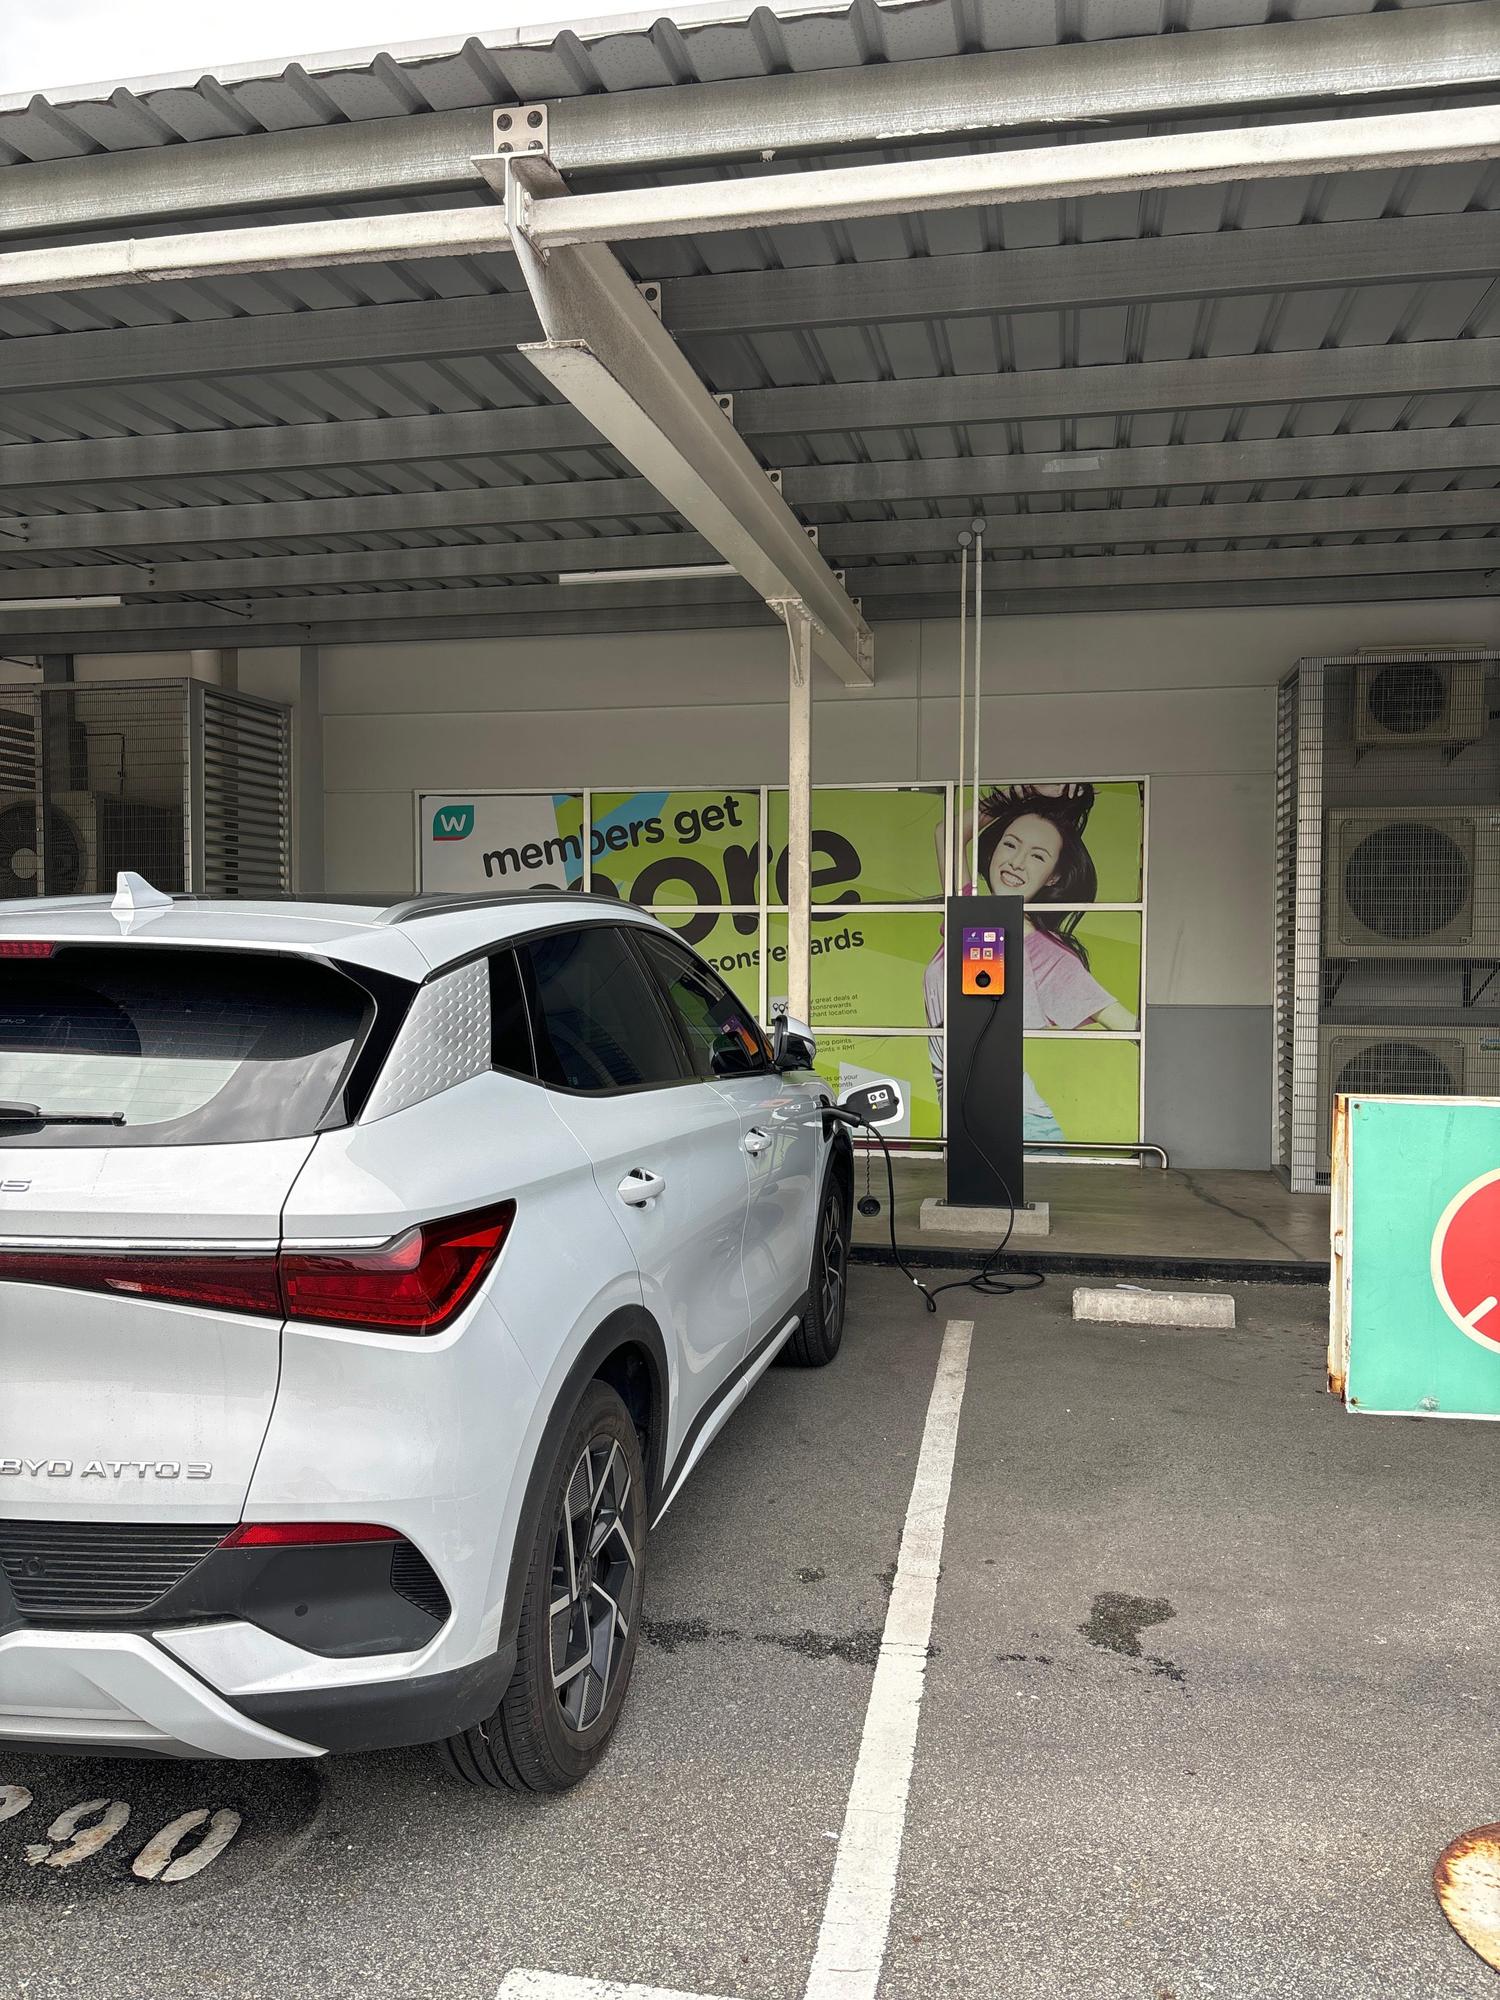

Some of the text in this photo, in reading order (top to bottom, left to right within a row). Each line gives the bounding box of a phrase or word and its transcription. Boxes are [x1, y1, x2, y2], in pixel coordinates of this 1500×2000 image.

[482, 795, 743, 878] members get
[529, 829, 862, 945] ore
[831, 1038, 852, 1046] points
[0, 1458, 213, 1479] BYD ATTO 3
